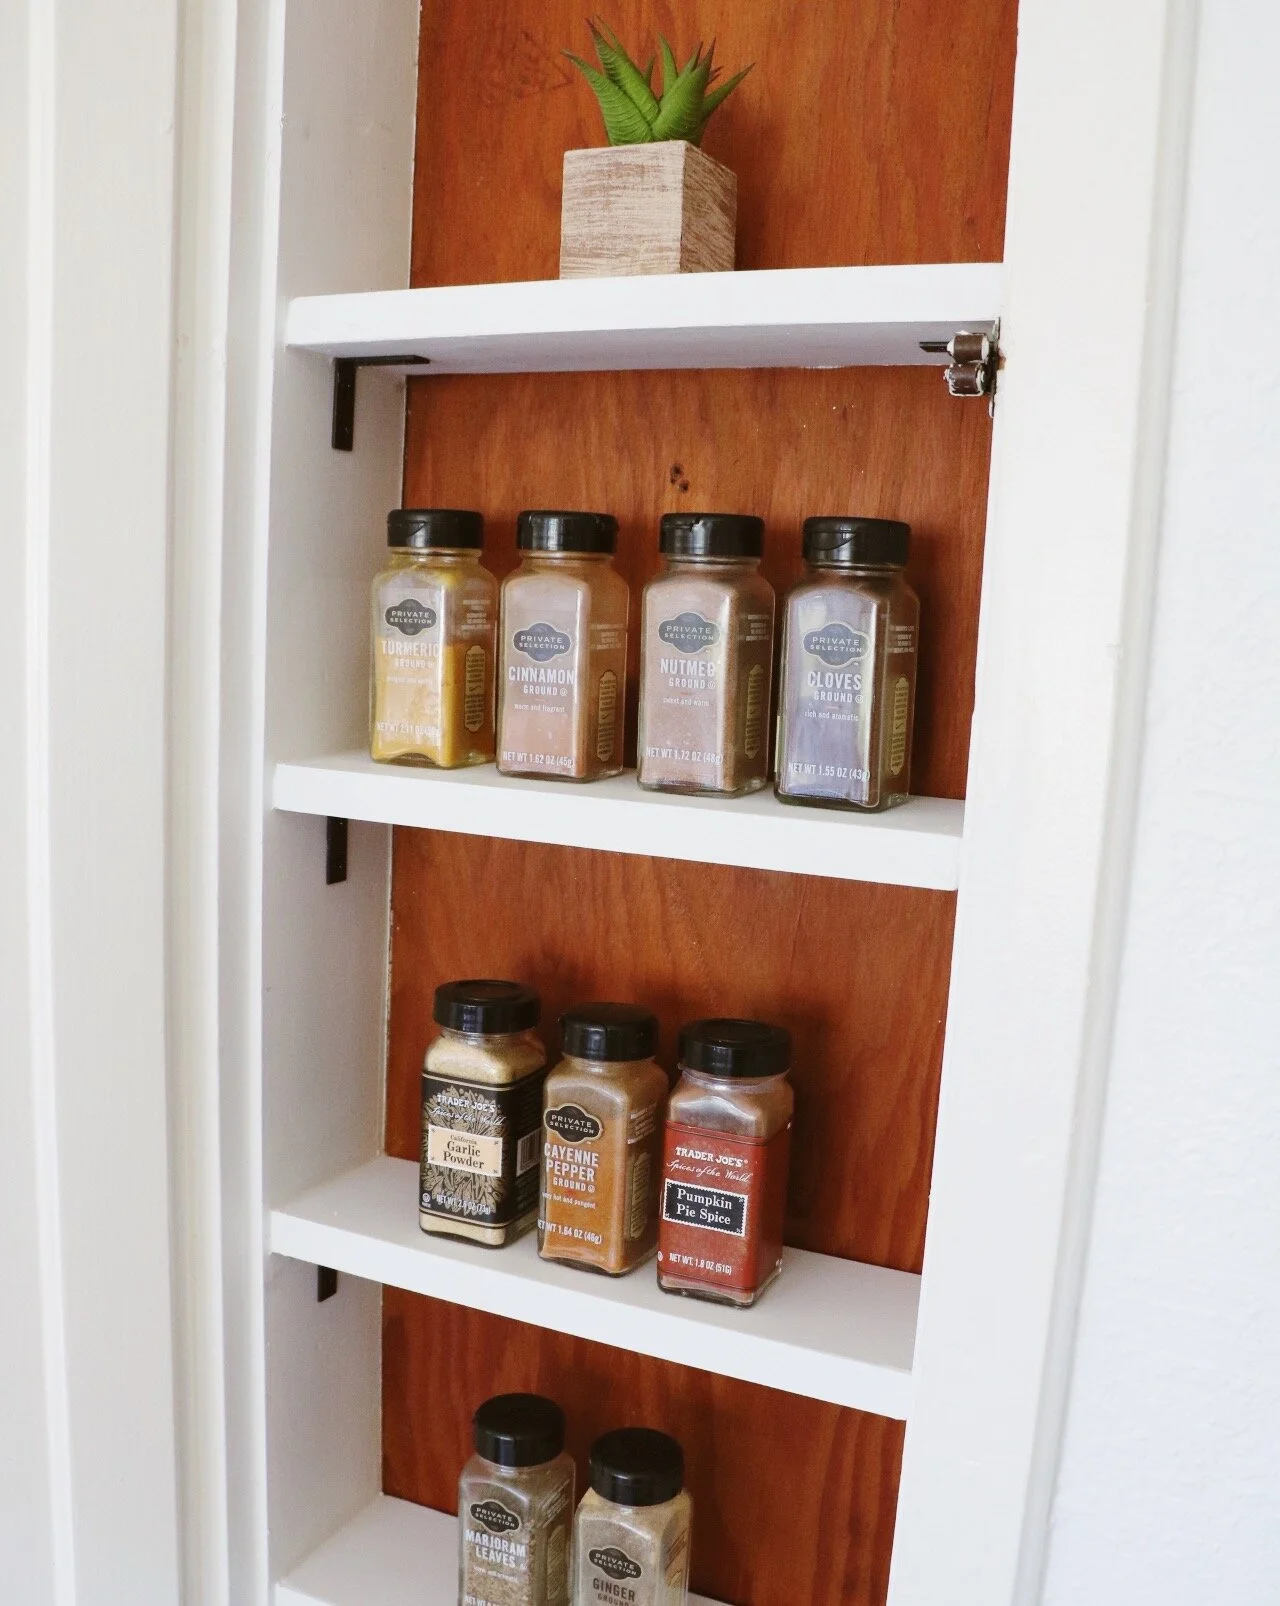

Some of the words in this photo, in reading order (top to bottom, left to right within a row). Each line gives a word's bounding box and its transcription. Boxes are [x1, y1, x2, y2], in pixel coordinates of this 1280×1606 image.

[389, 617, 432, 625] SELECTION
[391, 610, 430, 618] PRIVATE
[664, 633, 714, 641] SELECTION
[666, 626, 711, 634] PRIVATE
[519, 642, 565, 650] SELECTION
[521, 635, 562, 644] PRIVATE
[812, 636, 860, 646] PRIVATE
[381, 640, 440, 657] TURMERIC
[810, 644, 862, 653] SELECTION
[508, 665, 576, 685] CINNAMON
[660, 658, 716, 678] NUTMEG
[668, 677, 706, 690] GROUND
[807, 671, 862, 691] CLOVES
[523, 684, 558, 696] GROUND
[813, 690, 853, 703] GROUND
[804, 708, 817, 718] rich
[818, 711, 830, 719] and
[831, 712, 859, 722] aromatic
[503, 750, 515, 761] NET
[517, 752, 528, 763] WT
[545, 754, 555, 765] OZ
[661, 748, 673, 759] WT
[674, 749, 690, 761] 1.72
[691, 751, 702, 762] OZ
[788, 762, 802, 773] NET
[804, 763, 817, 775] WT
[818, 764, 835, 777] 1.55
[836, 767, 848, 778] OZ
[436, 1094, 470, 1109] TRADER
[471, 1101, 497, 1113] JOE'S
[549, 1121, 595, 1135] SELECTION
[551, 1114, 592, 1128] PRIVATE
[447, 1140, 481, 1157] Garlic
[544, 1142, 599, 1168] CAYENNE
[443, 1151, 485, 1170] Powder
[675, 1146, 714, 1163] TRADER
[715, 1154, 744, 1169] JOE'S
[545, 1158, 595, 1183] PEPPER
[666, 1159, 695, 1172] Spices
[724, 1168, 754, 1183] World
[552, 1176, 586, 1194] GROUND
[436, 1193, 447, 1204] NET
[677, 1187, 733, 1210] Pumpkin
[676, 1202, 696, 1218] Pie
[699, 1208, 731, 1225] Spice
[545, 1222, 557, 1233] WT
[573, 1228, 583, 1240] OZ
[669, 1252, 681, 1263] NET
[681, 1255, 694, 1267] WT.
[705, 1260, 714, 1271] OZ
[475, 1506, 513, 1522] PRIVATE
[475, 1512, 516, 1528] SELECTION
[464, 1528, 526, 1558] MARJORAM
[475, 1545, 516, 1569] LEAVES
[595, 1552, 635, 1570] PRIVATE
[593, 1557, 637, 1576] SELECTION
[592, 1577, 636, 1603] GINGER
